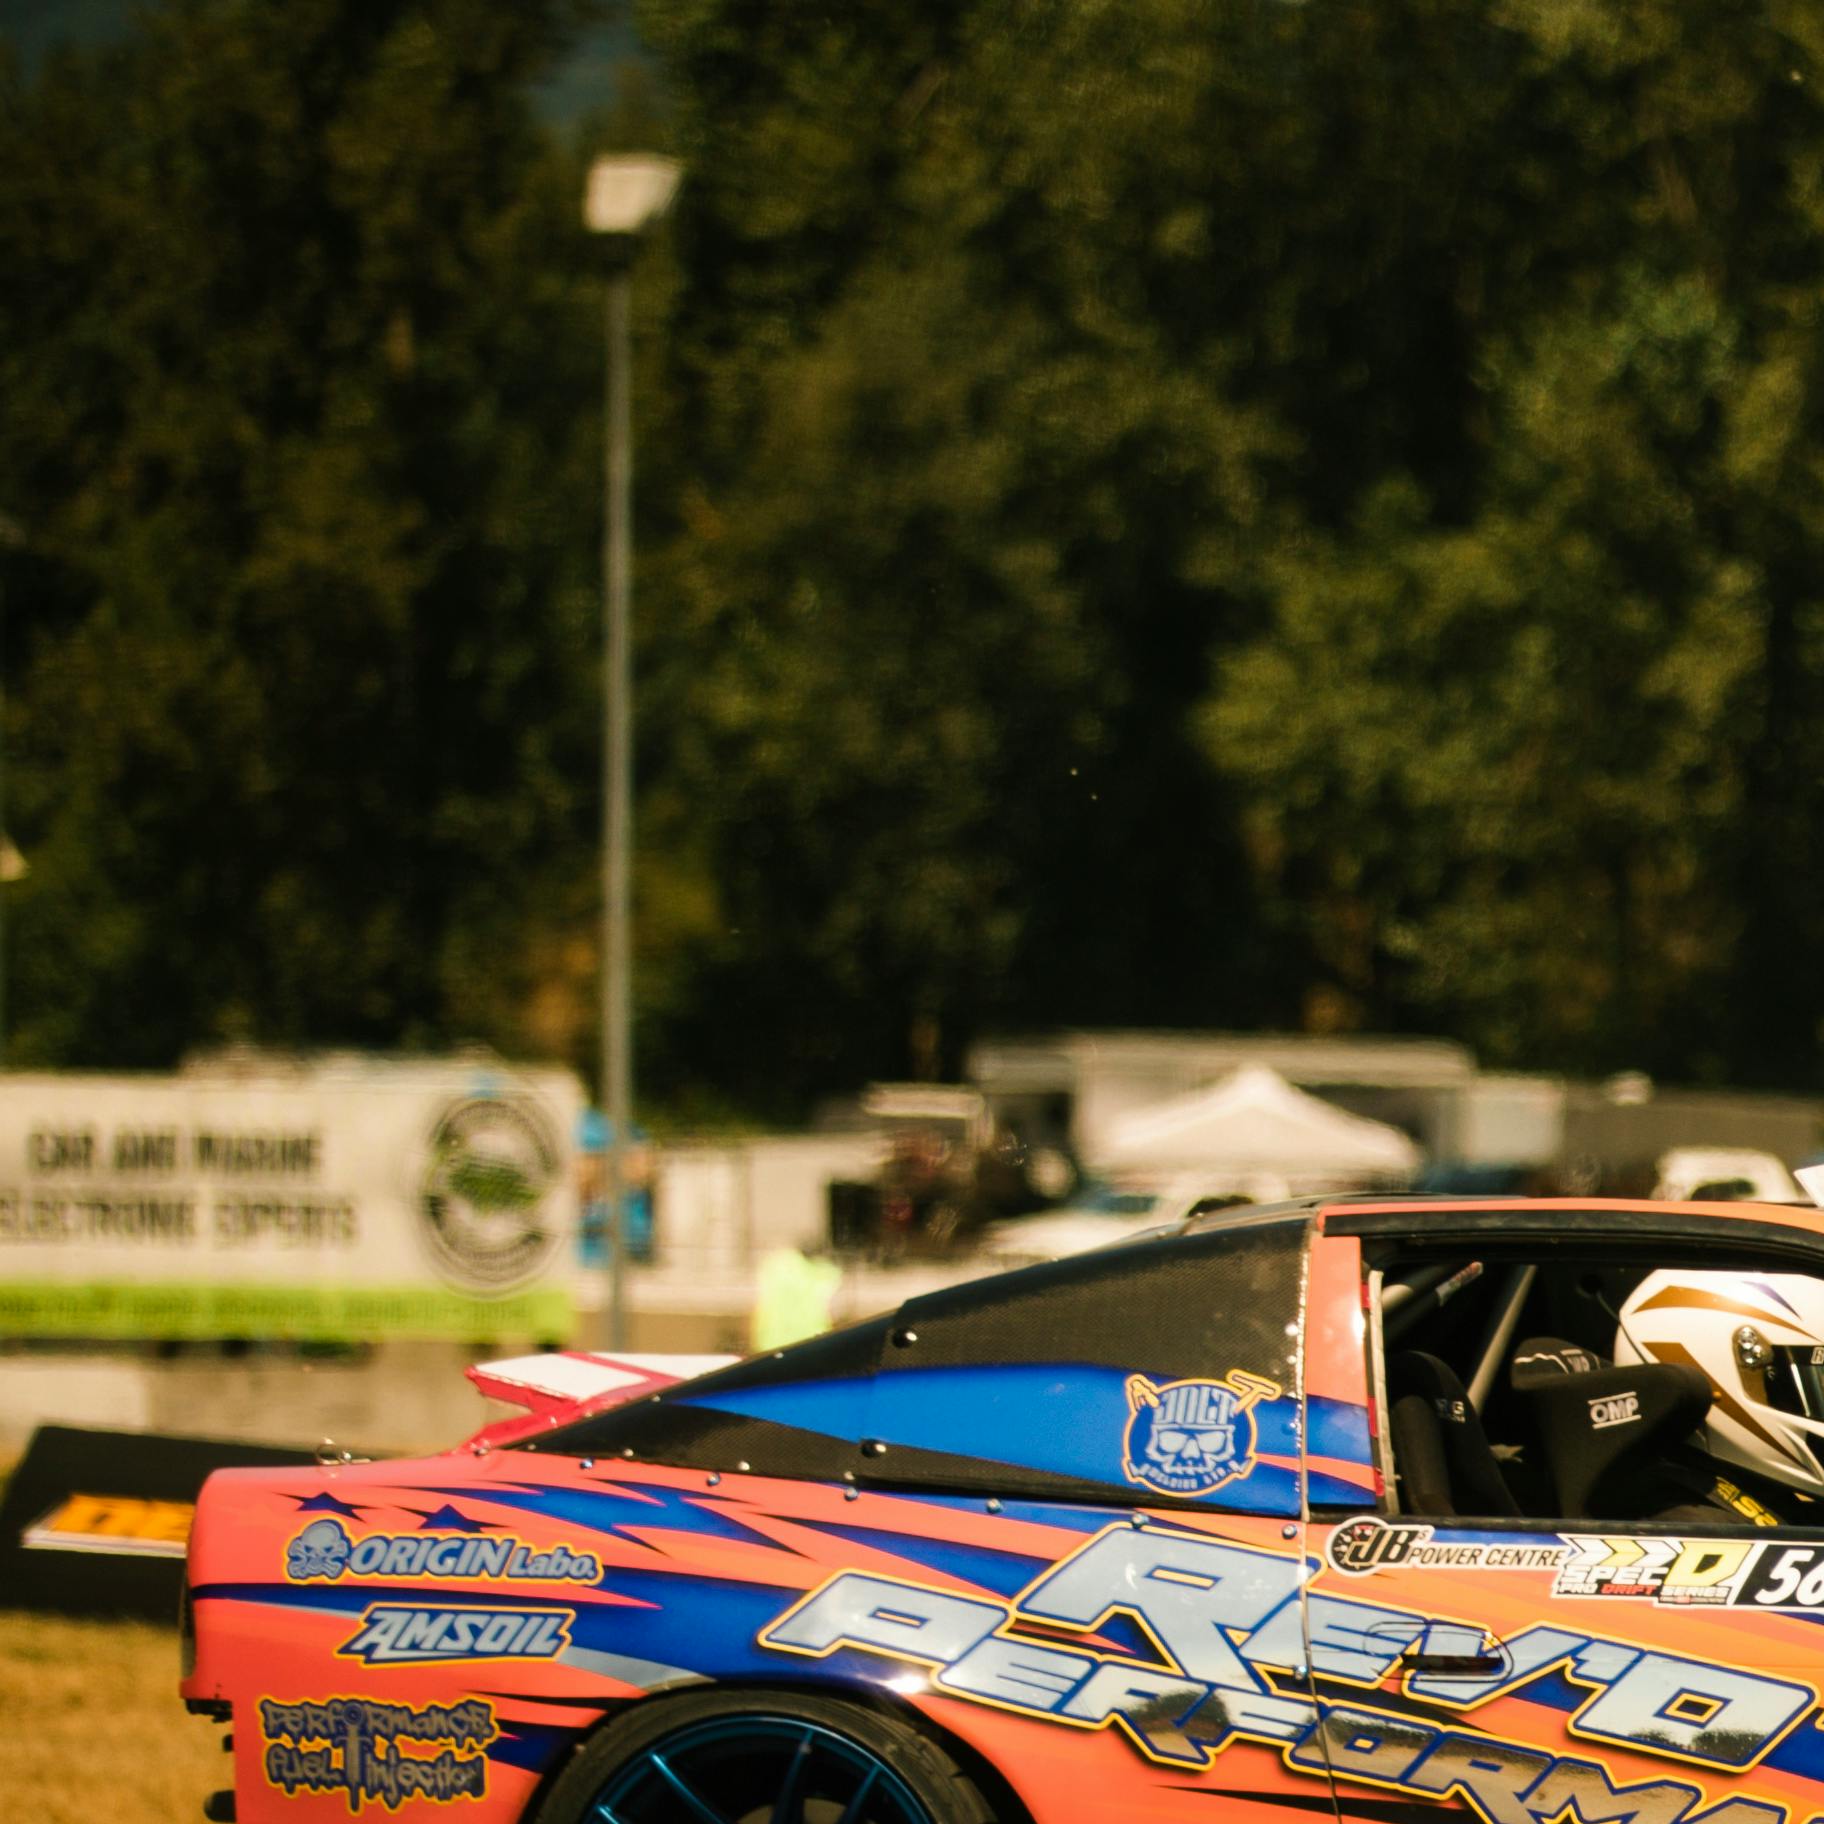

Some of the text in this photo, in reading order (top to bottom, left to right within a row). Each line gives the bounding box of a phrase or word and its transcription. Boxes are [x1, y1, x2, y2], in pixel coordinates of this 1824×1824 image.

[1590, 1397, 1639, 1424] OMP
[349, 1535, 516, 1577] ORIGIN
[1406, 1545, 1567, 1568] POWER CENTRE
[1560, 1565, 1670, 1586] SPEC
[1601, 1584, 1659, 1595] DRIFT
[1659, 1585, 1731, 1598] SERIES
[350, 1607, 569, 1661] AMSOIL
